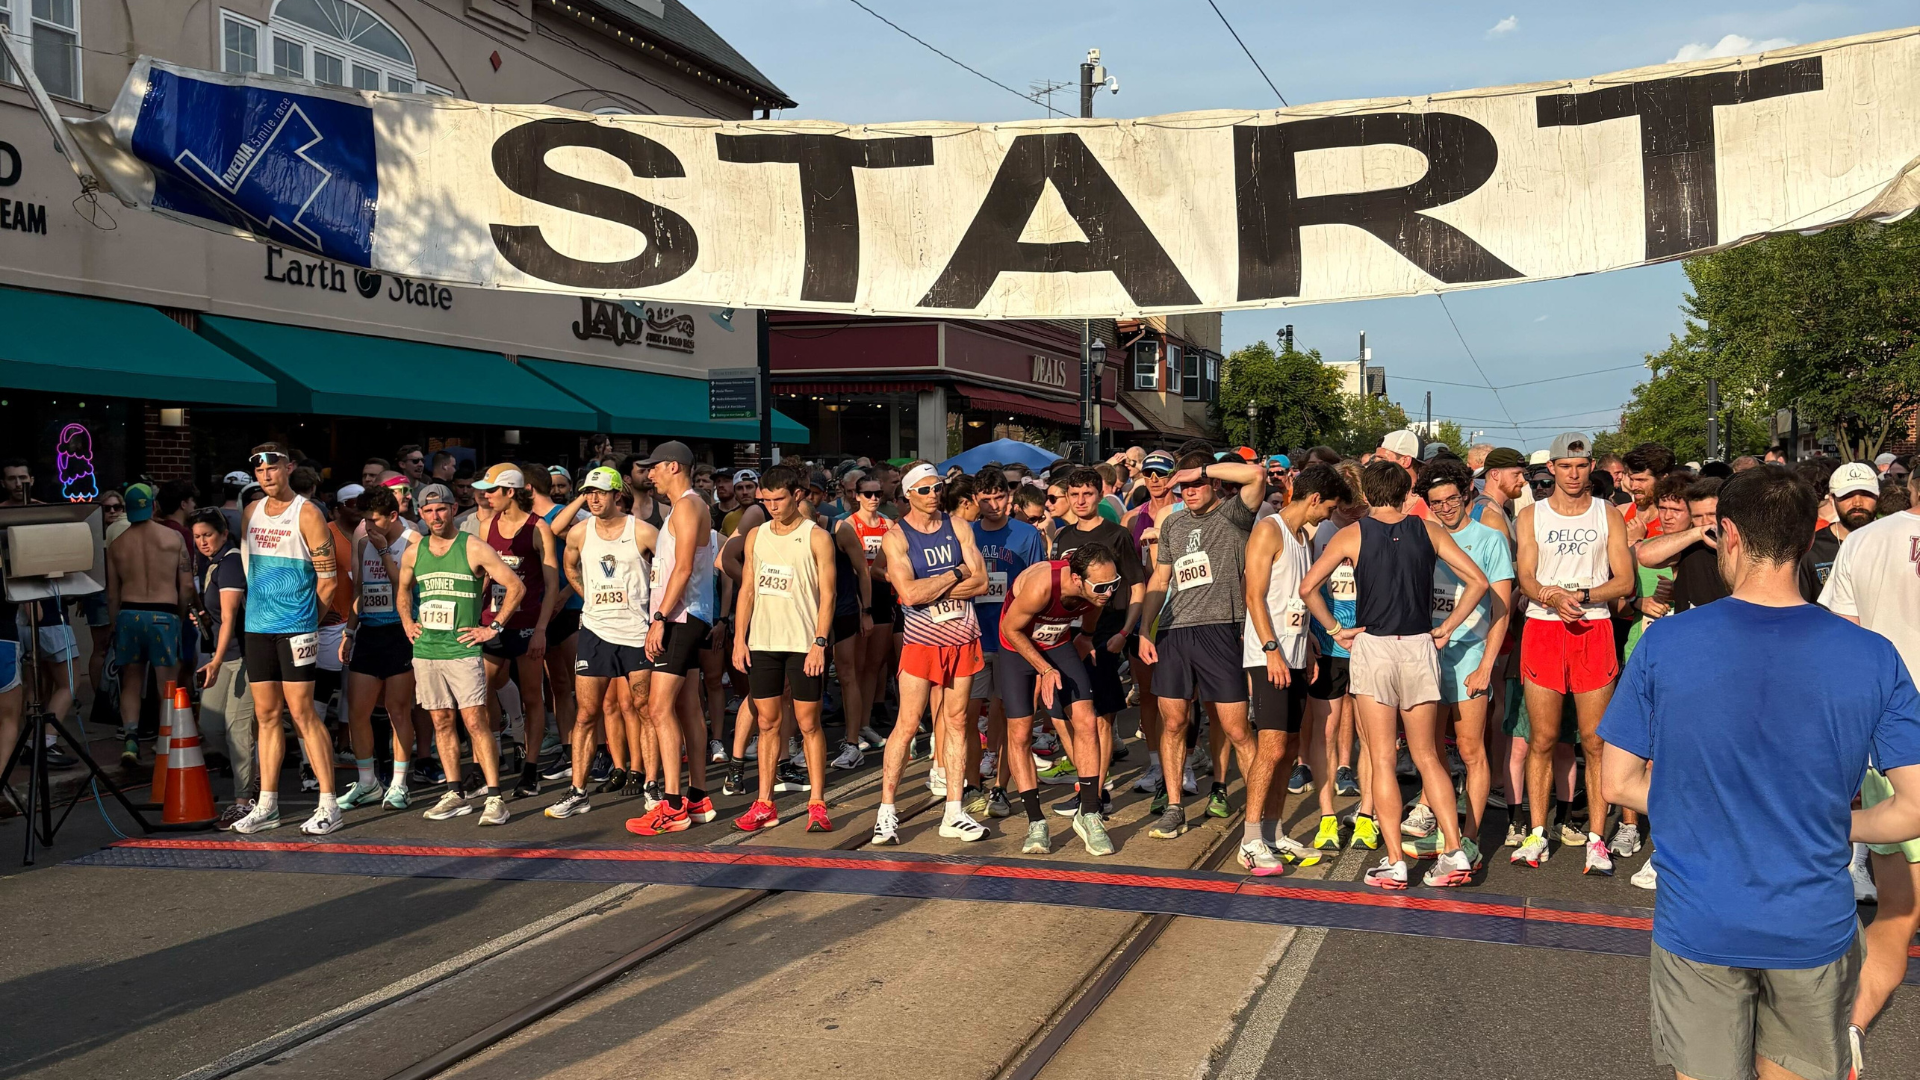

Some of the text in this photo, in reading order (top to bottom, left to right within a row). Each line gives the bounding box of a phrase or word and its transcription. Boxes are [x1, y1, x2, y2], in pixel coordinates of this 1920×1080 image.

[222, 143, 256, 185] MEDIA
[273, 97, 291, 119] race
[488, 55, 1823, 308] START
[264, 245, 347, 293] Earth
[572, 297, 643, 347] JACO
[250, 527, 292, 537] BRYN MAWR
[254, 534, 281, 542] RACING
[1544, 528, 1598, 544] DELCO
[257, 541, 277, 549] TEAM
[1554, 541, 1589, 556] RRC
[924, 543, 952, 567] DW
[1179, 564, 1207, 583] 2608
[758, 575, 788, 591] 2433
[1331, 580, 1355, 594] 271
[363, 595, 389, 607] 2380
[595, 591, 623, 605] 2483
[934, 599, 963, 615] 1874
[422, 610, 449, 624] 1131
[1037, 631, 1062, 642] 221
[297, 643, 319, 659] 220
